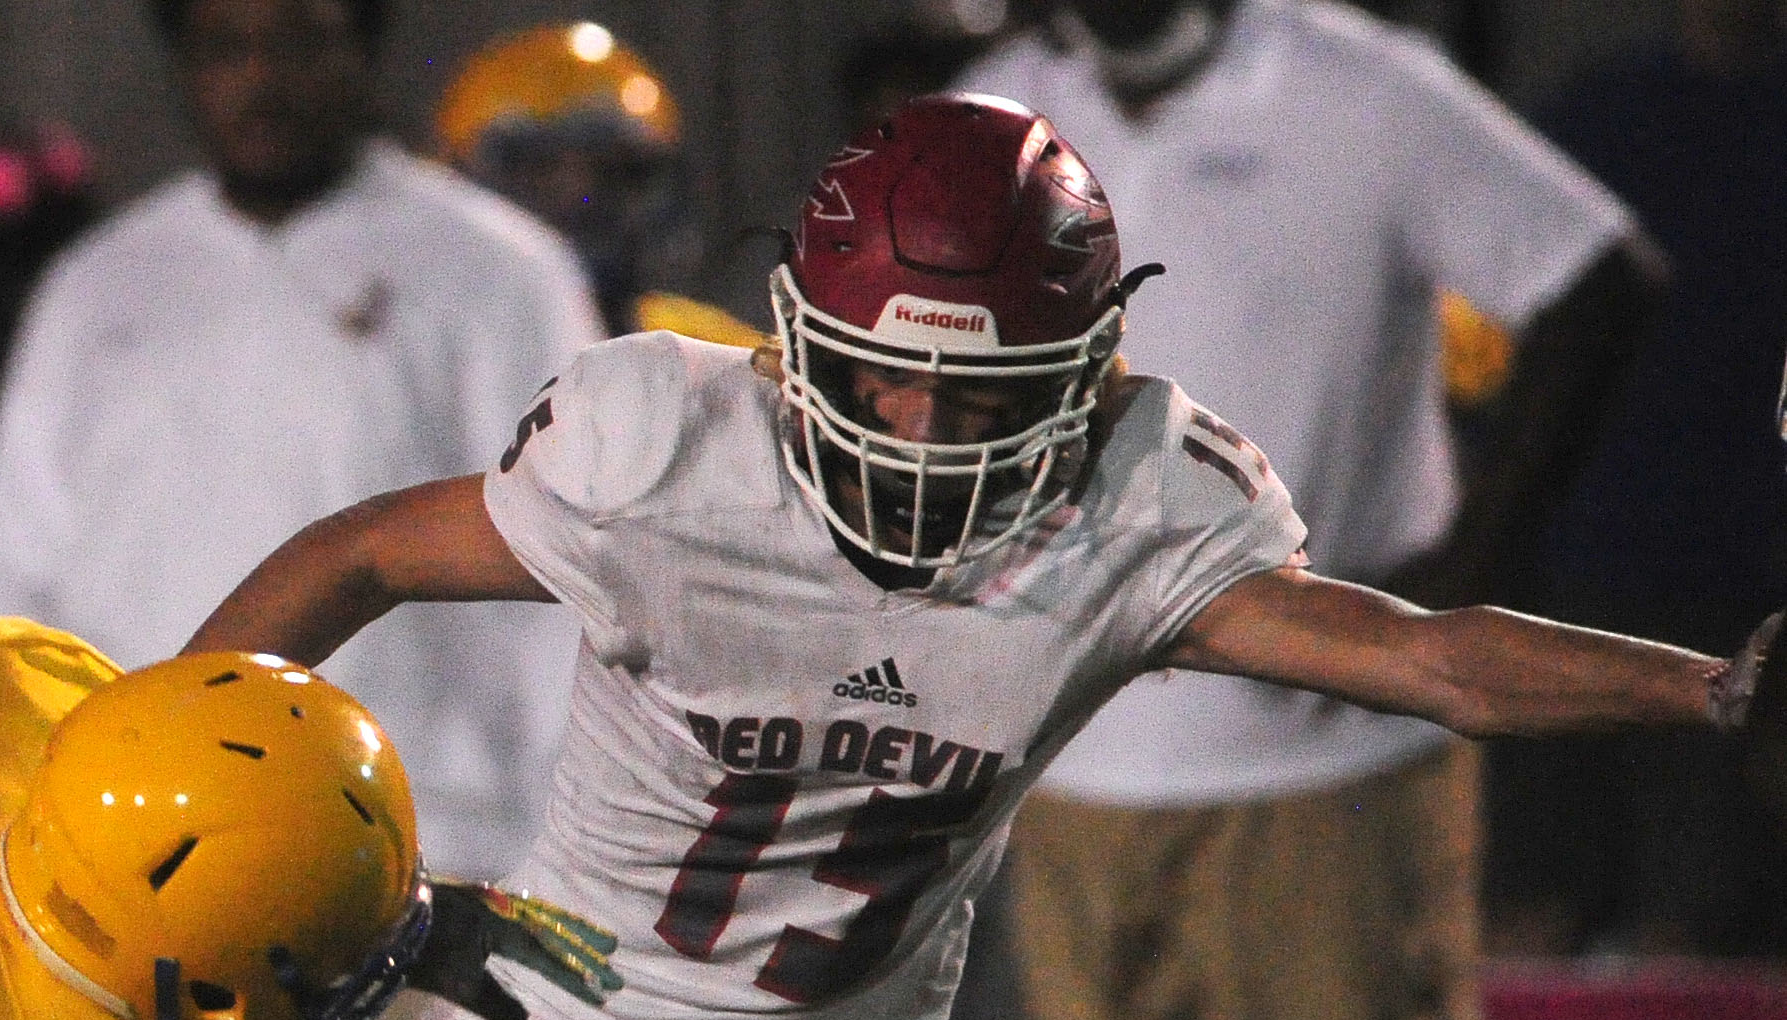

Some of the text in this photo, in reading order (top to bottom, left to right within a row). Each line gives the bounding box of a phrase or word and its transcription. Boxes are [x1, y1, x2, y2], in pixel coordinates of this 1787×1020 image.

[894, 304, 987, 332] Riddell
[832, 681, 918, 708] adidas
[654, 772, 984, 1003] 15
